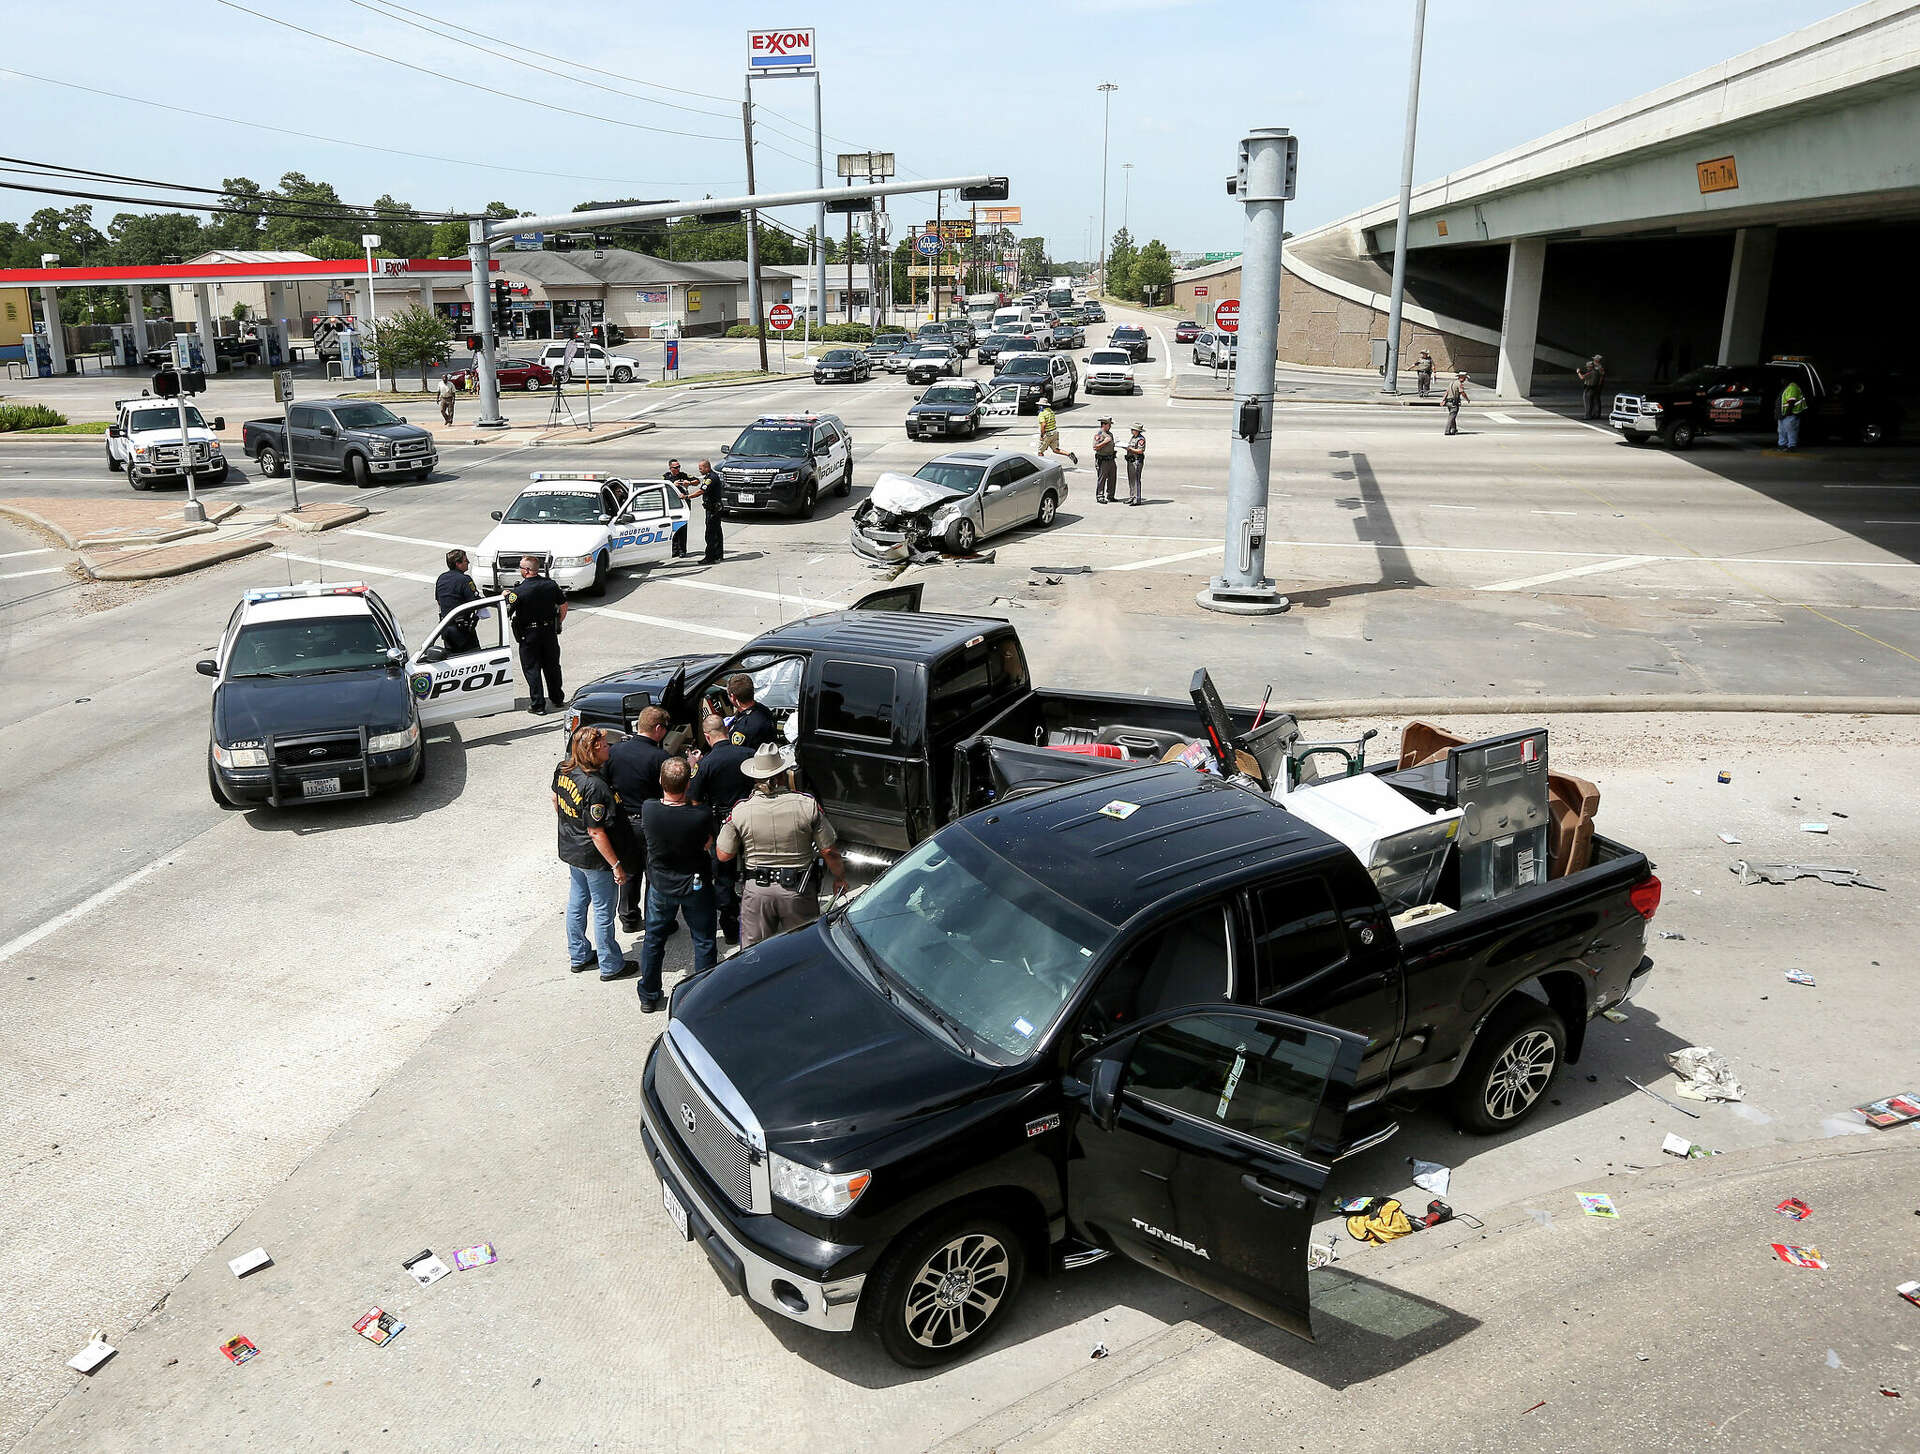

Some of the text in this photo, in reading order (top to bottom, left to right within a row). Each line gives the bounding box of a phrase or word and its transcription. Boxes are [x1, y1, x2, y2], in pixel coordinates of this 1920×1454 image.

[752, 32, 809, 55] EXXON
[384, 261, 409, 277] EXXON
[820, 458, 845, 480] POLICE
[619, 527, 651, 537] HOUSTON
[435, 663, 486, 681] HOUSTON
[1131, 1217, 1212, 1261] TUNDRA
